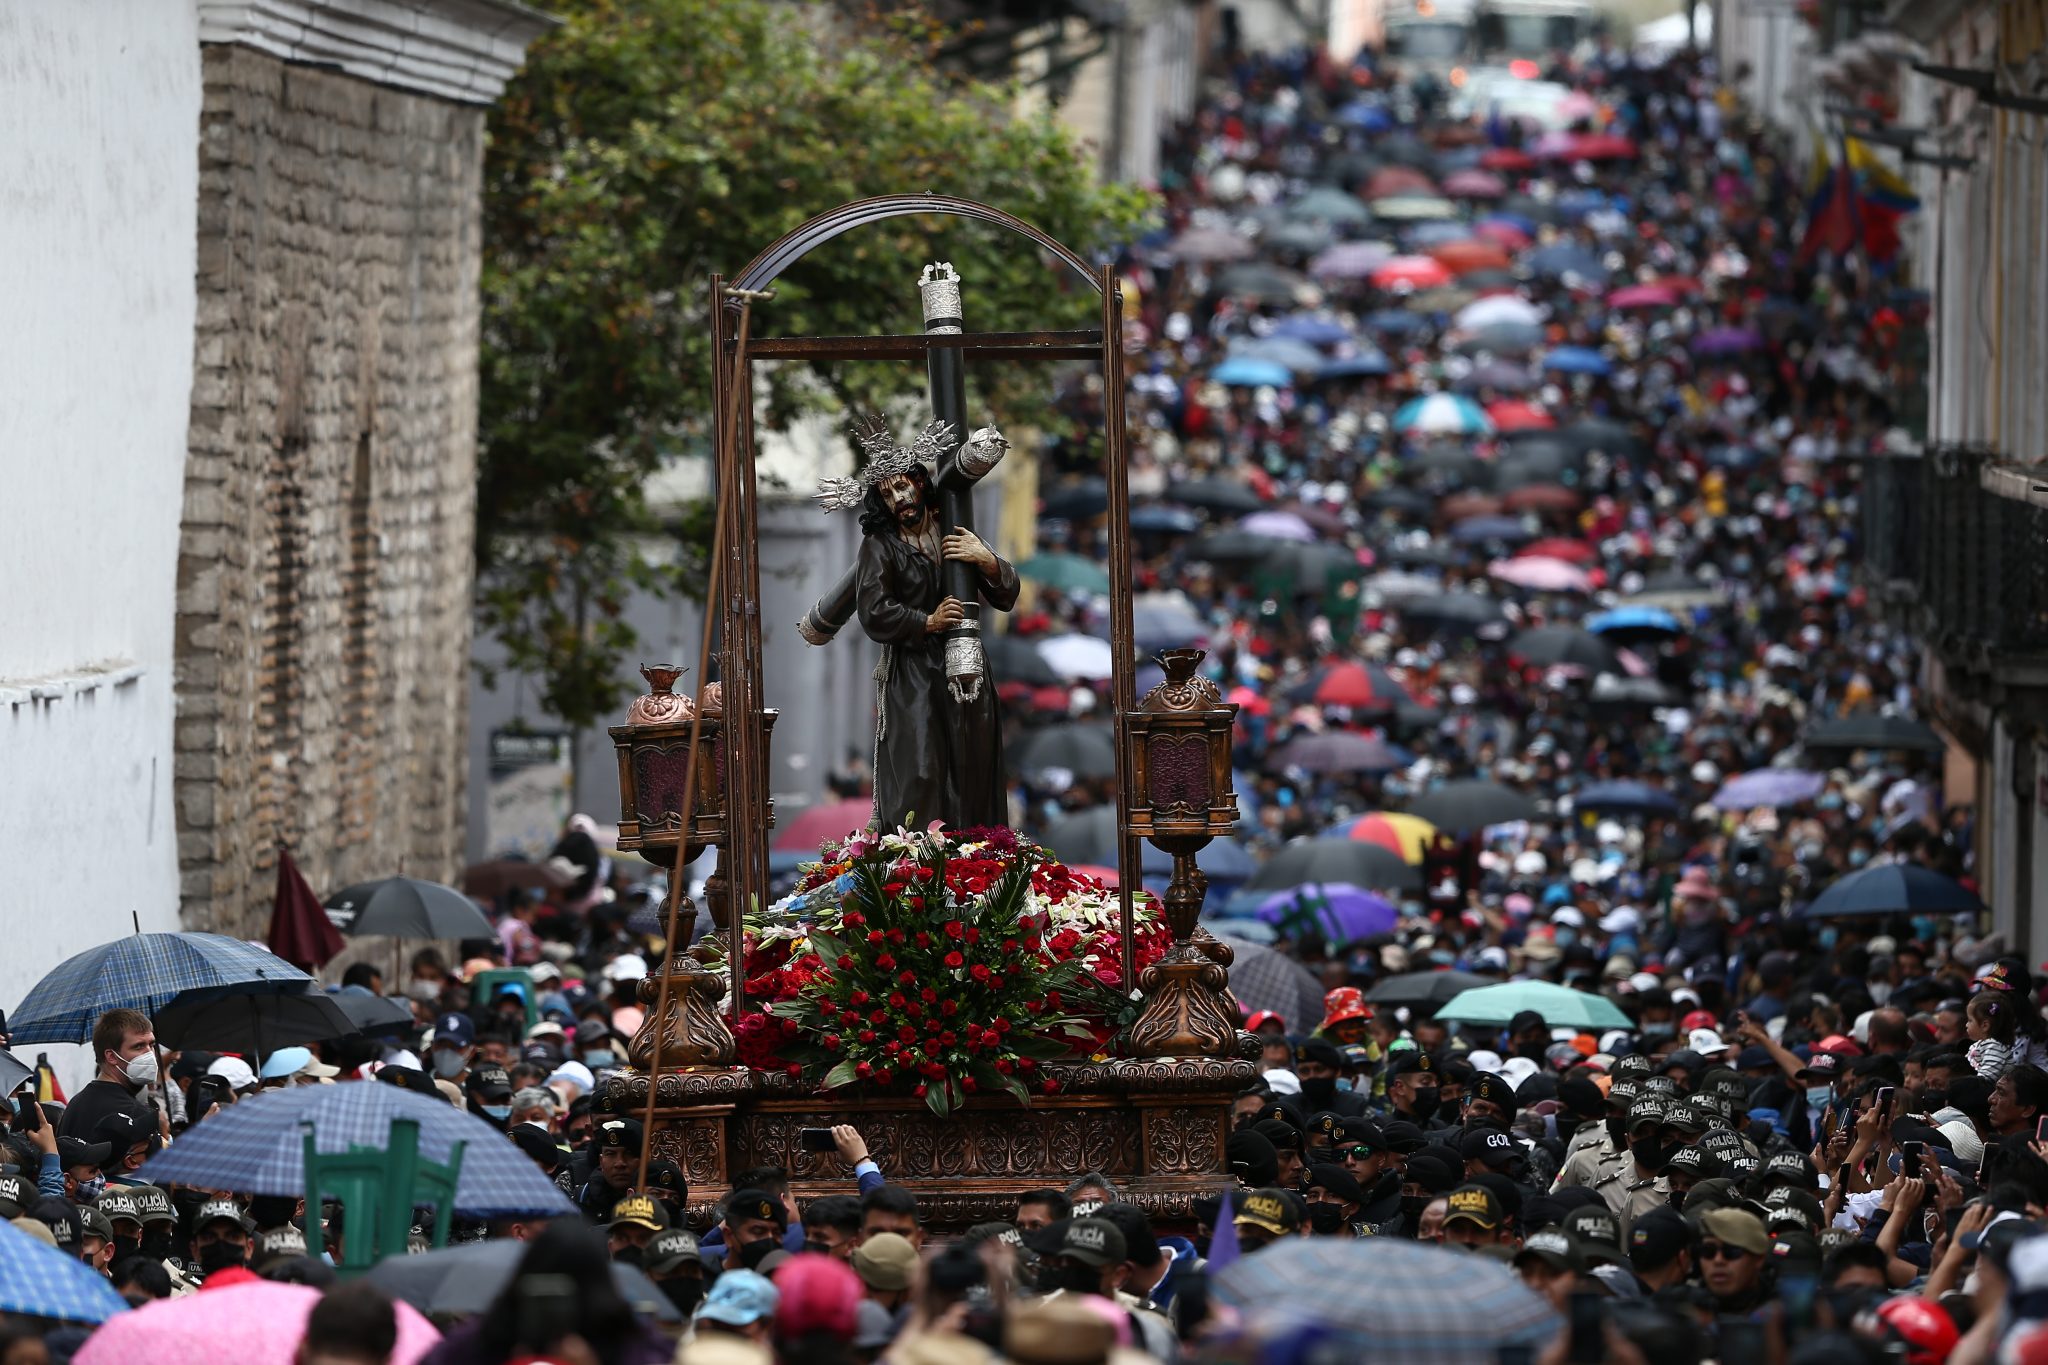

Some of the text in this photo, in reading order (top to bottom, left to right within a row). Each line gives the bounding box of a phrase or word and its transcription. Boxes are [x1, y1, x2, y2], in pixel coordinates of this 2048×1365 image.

[1610, 1082, 1636, 1095] OLICÍA
[1631, 1099, 1662, 1116] POLICÍA
[1663, 1109, 1692, 1124] POLICÍA
[1706, 1132, 1740, 1150] POLICÍA
[1734, 1158, 1759, 1169] POLIC
[1768, 1155, 1805, 1170] POLICÍA
[99, 1196, 137, 1211] POLICÍA
[138, 1193, 168, 1208] OLICÍA
[616, 1196, 654, 1217] POLICÍA
[54, 1218, 72, 1236] ICÍA
[998, 1229, 1021, 1246] POLI
